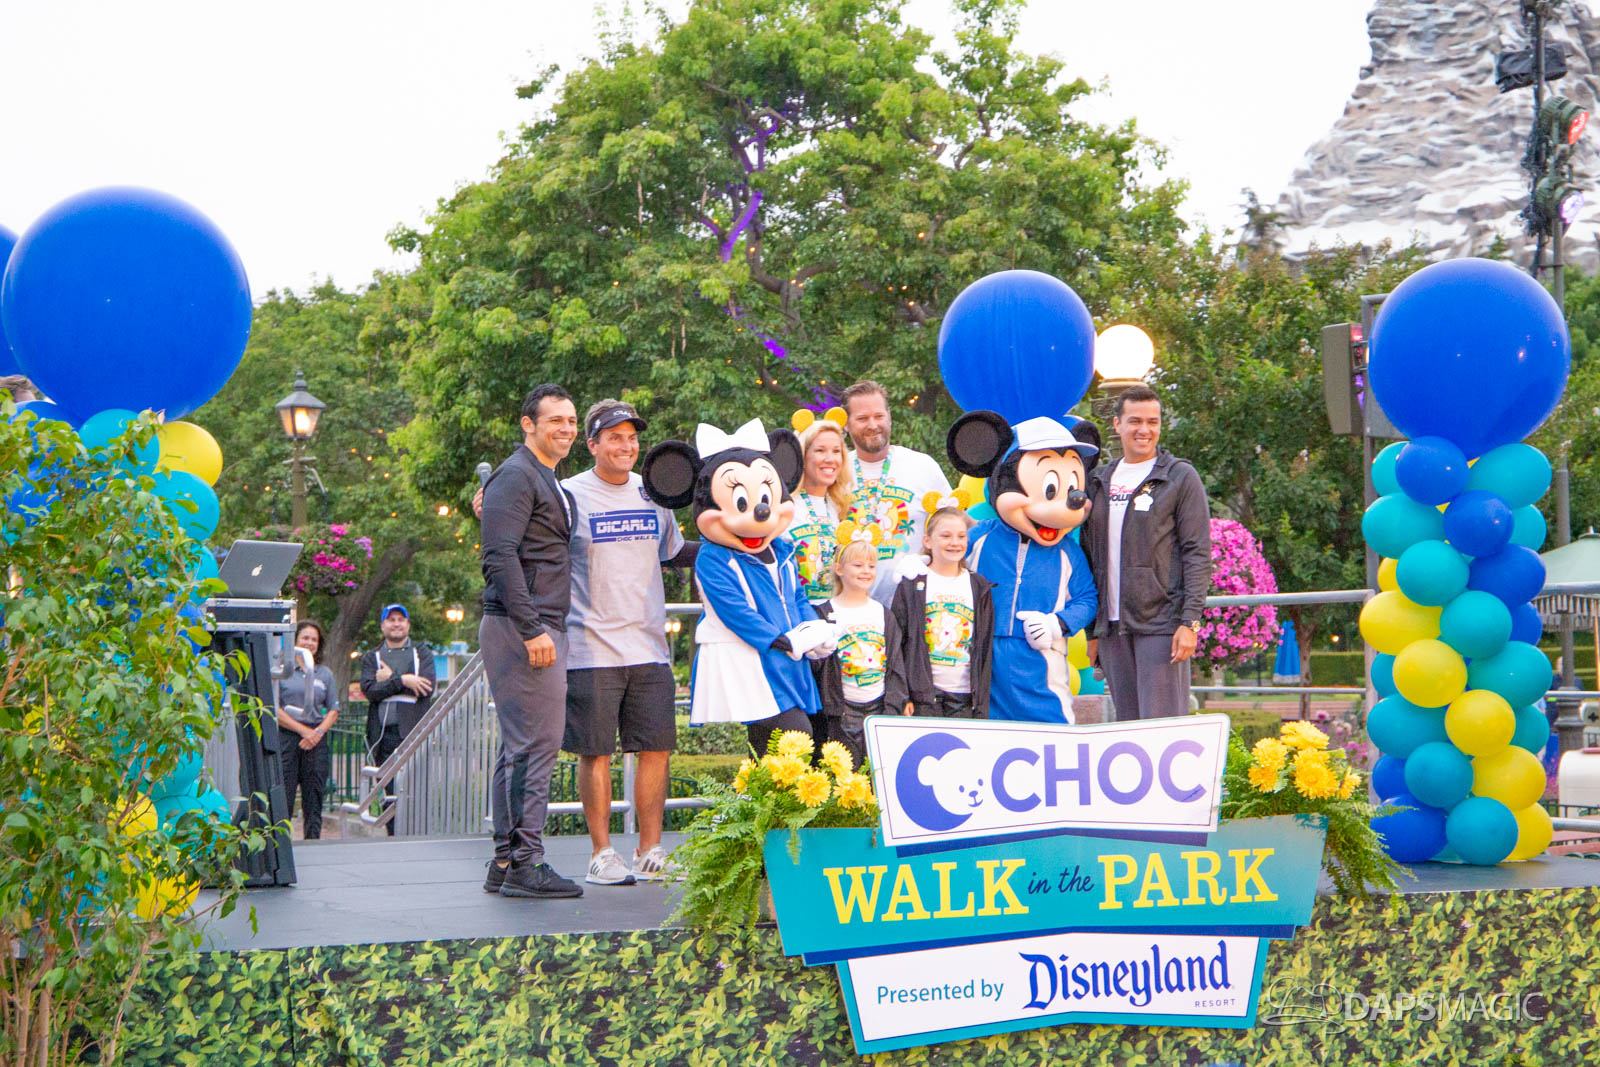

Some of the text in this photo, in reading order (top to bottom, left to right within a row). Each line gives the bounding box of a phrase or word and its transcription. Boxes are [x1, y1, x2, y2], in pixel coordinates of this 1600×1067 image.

[596, 519, 656, 534] DICARLO
[991, 740, 1206, 812] CHOC
[823, 848, 1278, 924] WALK in the PARK
[877, 940, 1231, 1010] Presented by Disneyland
[1194, 998, 1236, 1008] RESORT
